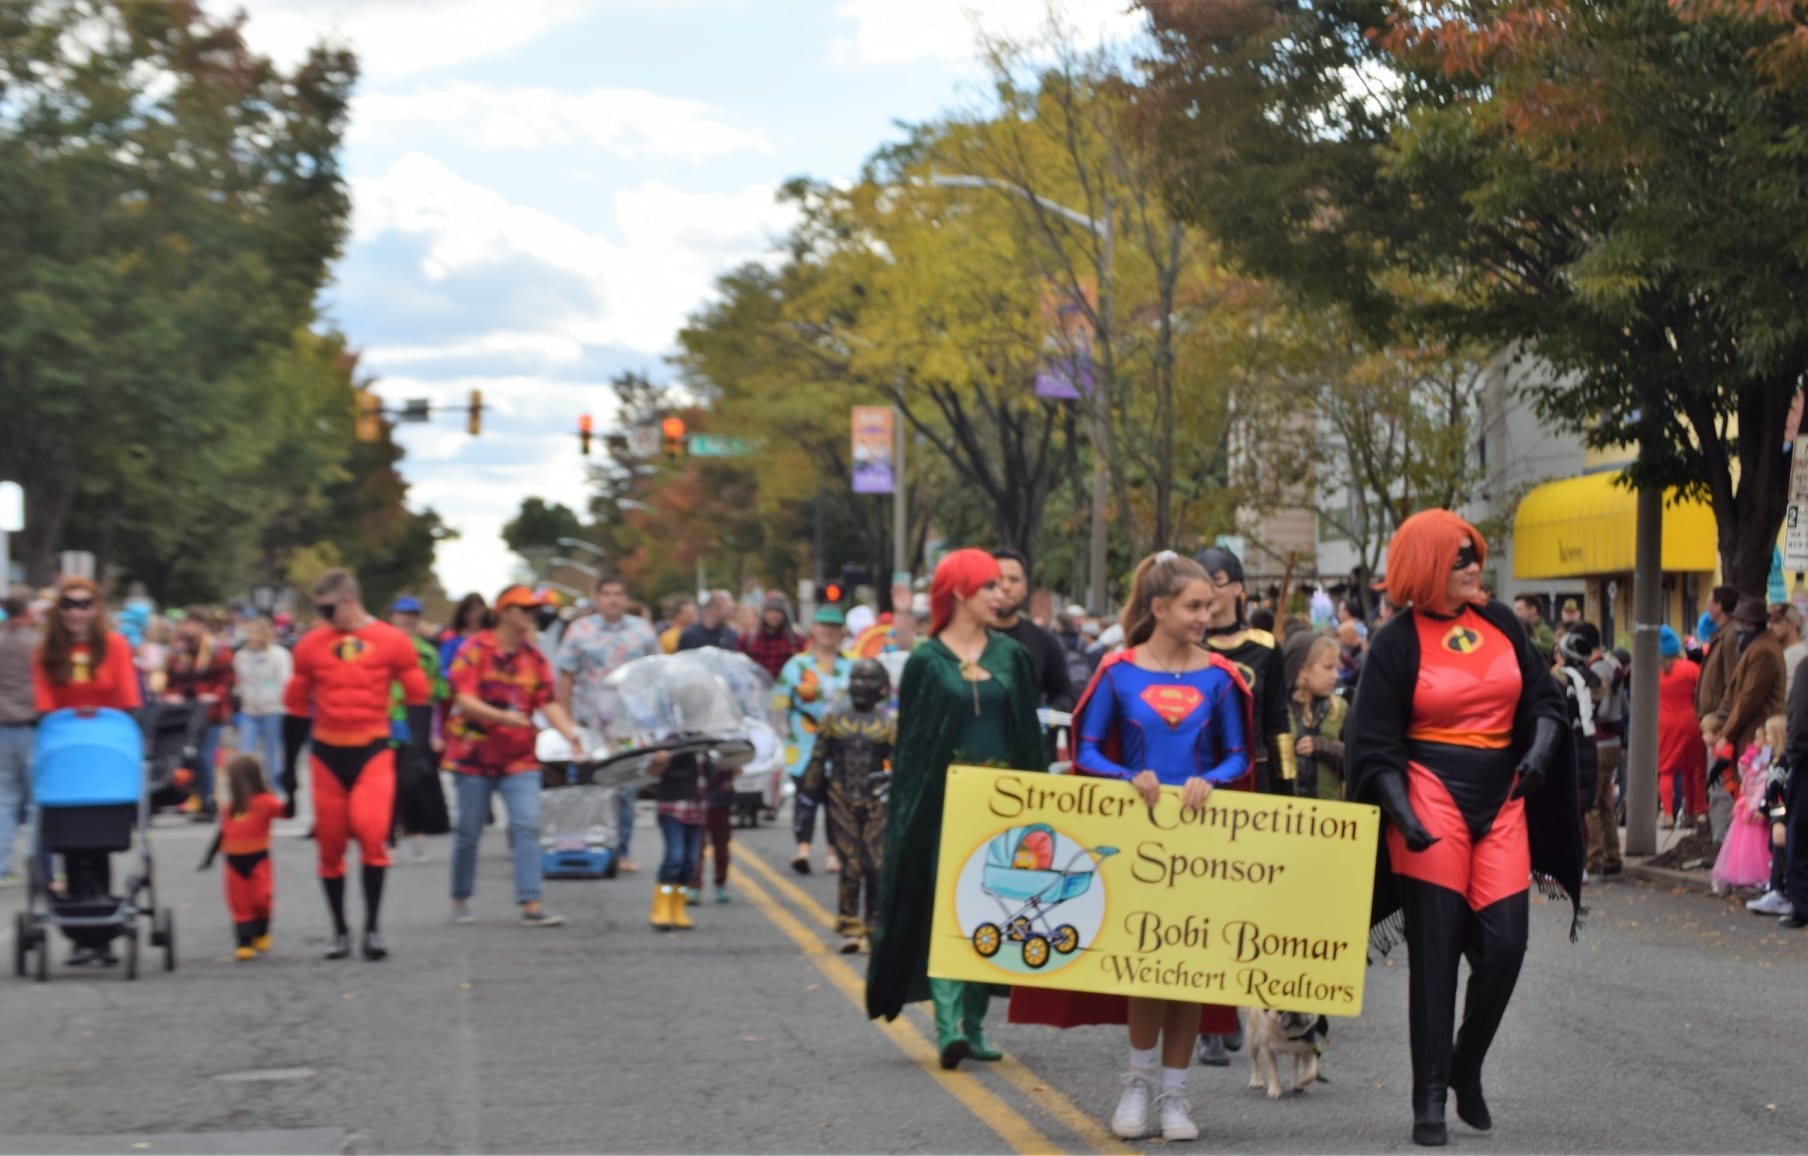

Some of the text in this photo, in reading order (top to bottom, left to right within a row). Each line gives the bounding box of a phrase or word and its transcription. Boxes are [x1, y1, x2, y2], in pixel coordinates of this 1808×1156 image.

[988, 775, 1359, 842] Stroller Competition
[1130, 840, 1286, 889] Sponsor
[1123, 910, 1348, 963] Bobi Bomar
[1100, 953, 1355, 1008] Weichert Realtors
